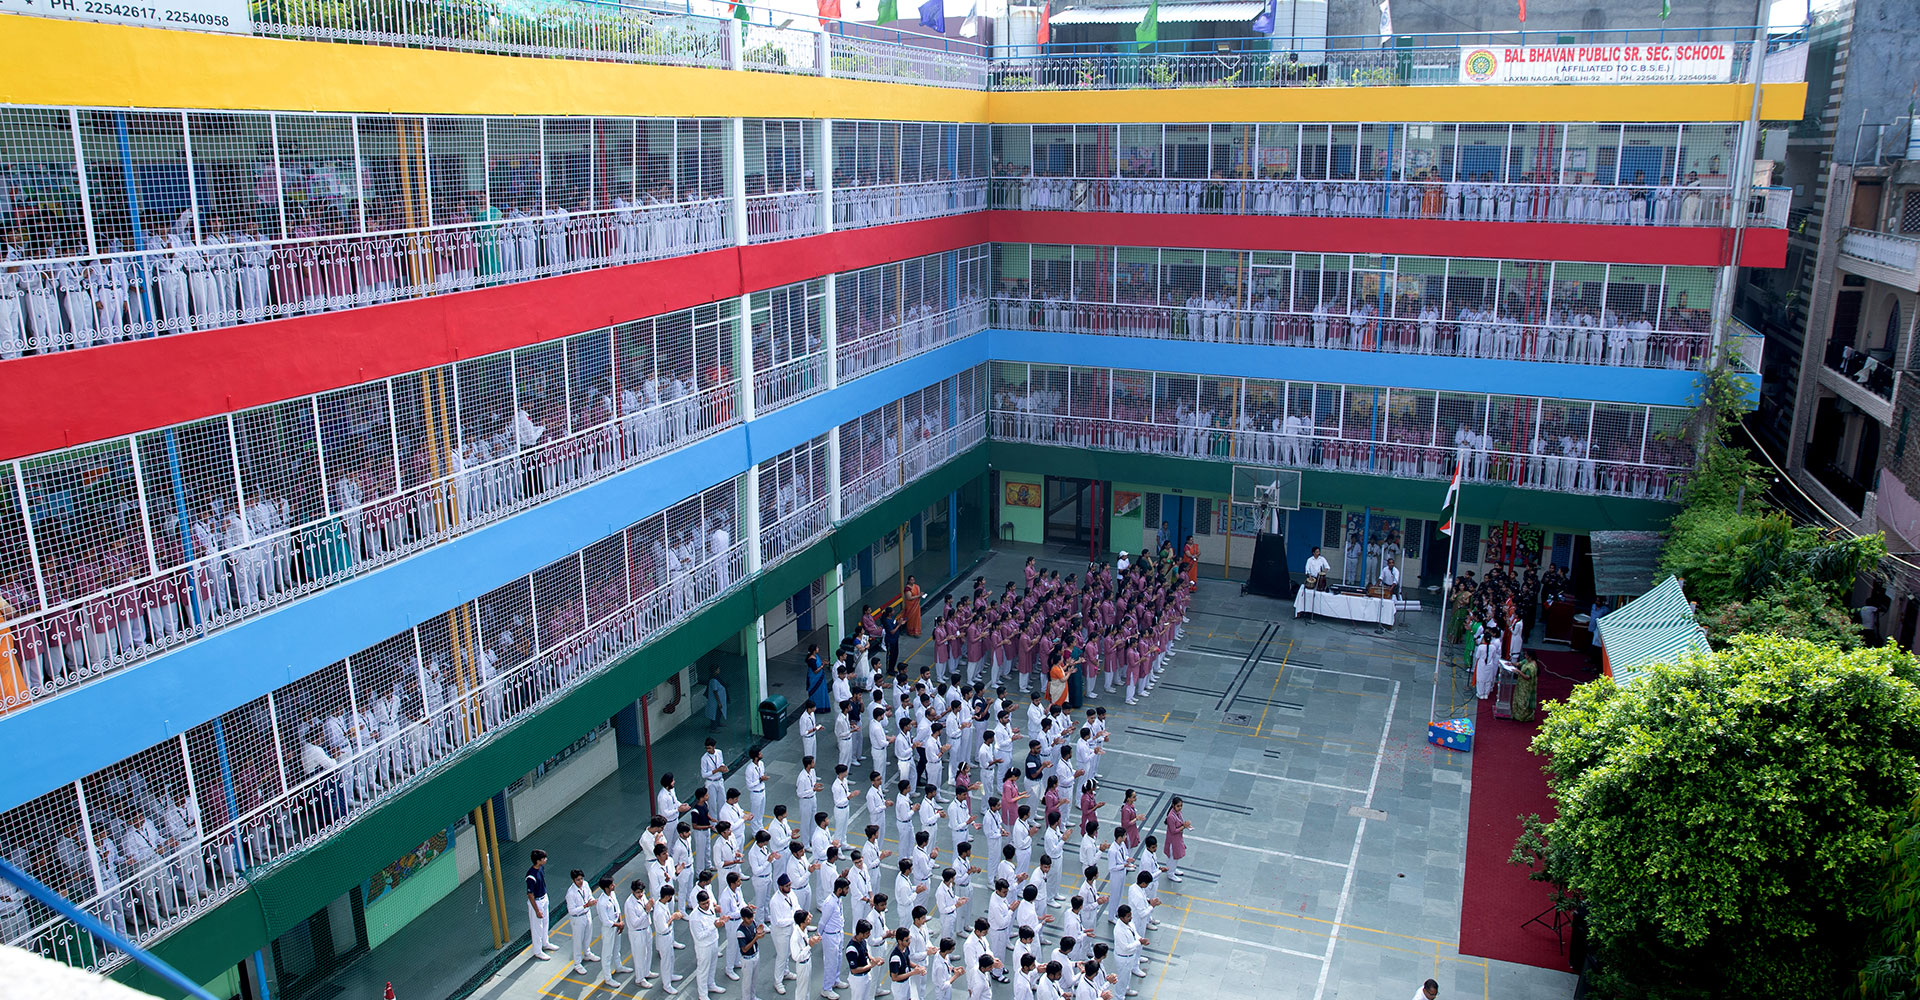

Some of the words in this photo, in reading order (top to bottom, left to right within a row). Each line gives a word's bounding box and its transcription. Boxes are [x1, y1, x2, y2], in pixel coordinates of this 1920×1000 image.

[49, 0, 80, 12] PH.
[84, 1, 162, 21] 22542617,
[165, 10, 230, 27] 22540958
[1504, 48, 1526, 63] BAL
[1529, 47, 1575, 63] BHAVAN
[1578, 46, 1621, 62] PUBLIC
[1623, 46, 1642, 61] SR.
[1646, 45, 1673, 61] SEC.
[1676, 44, 1726, 60] SCHOOL
